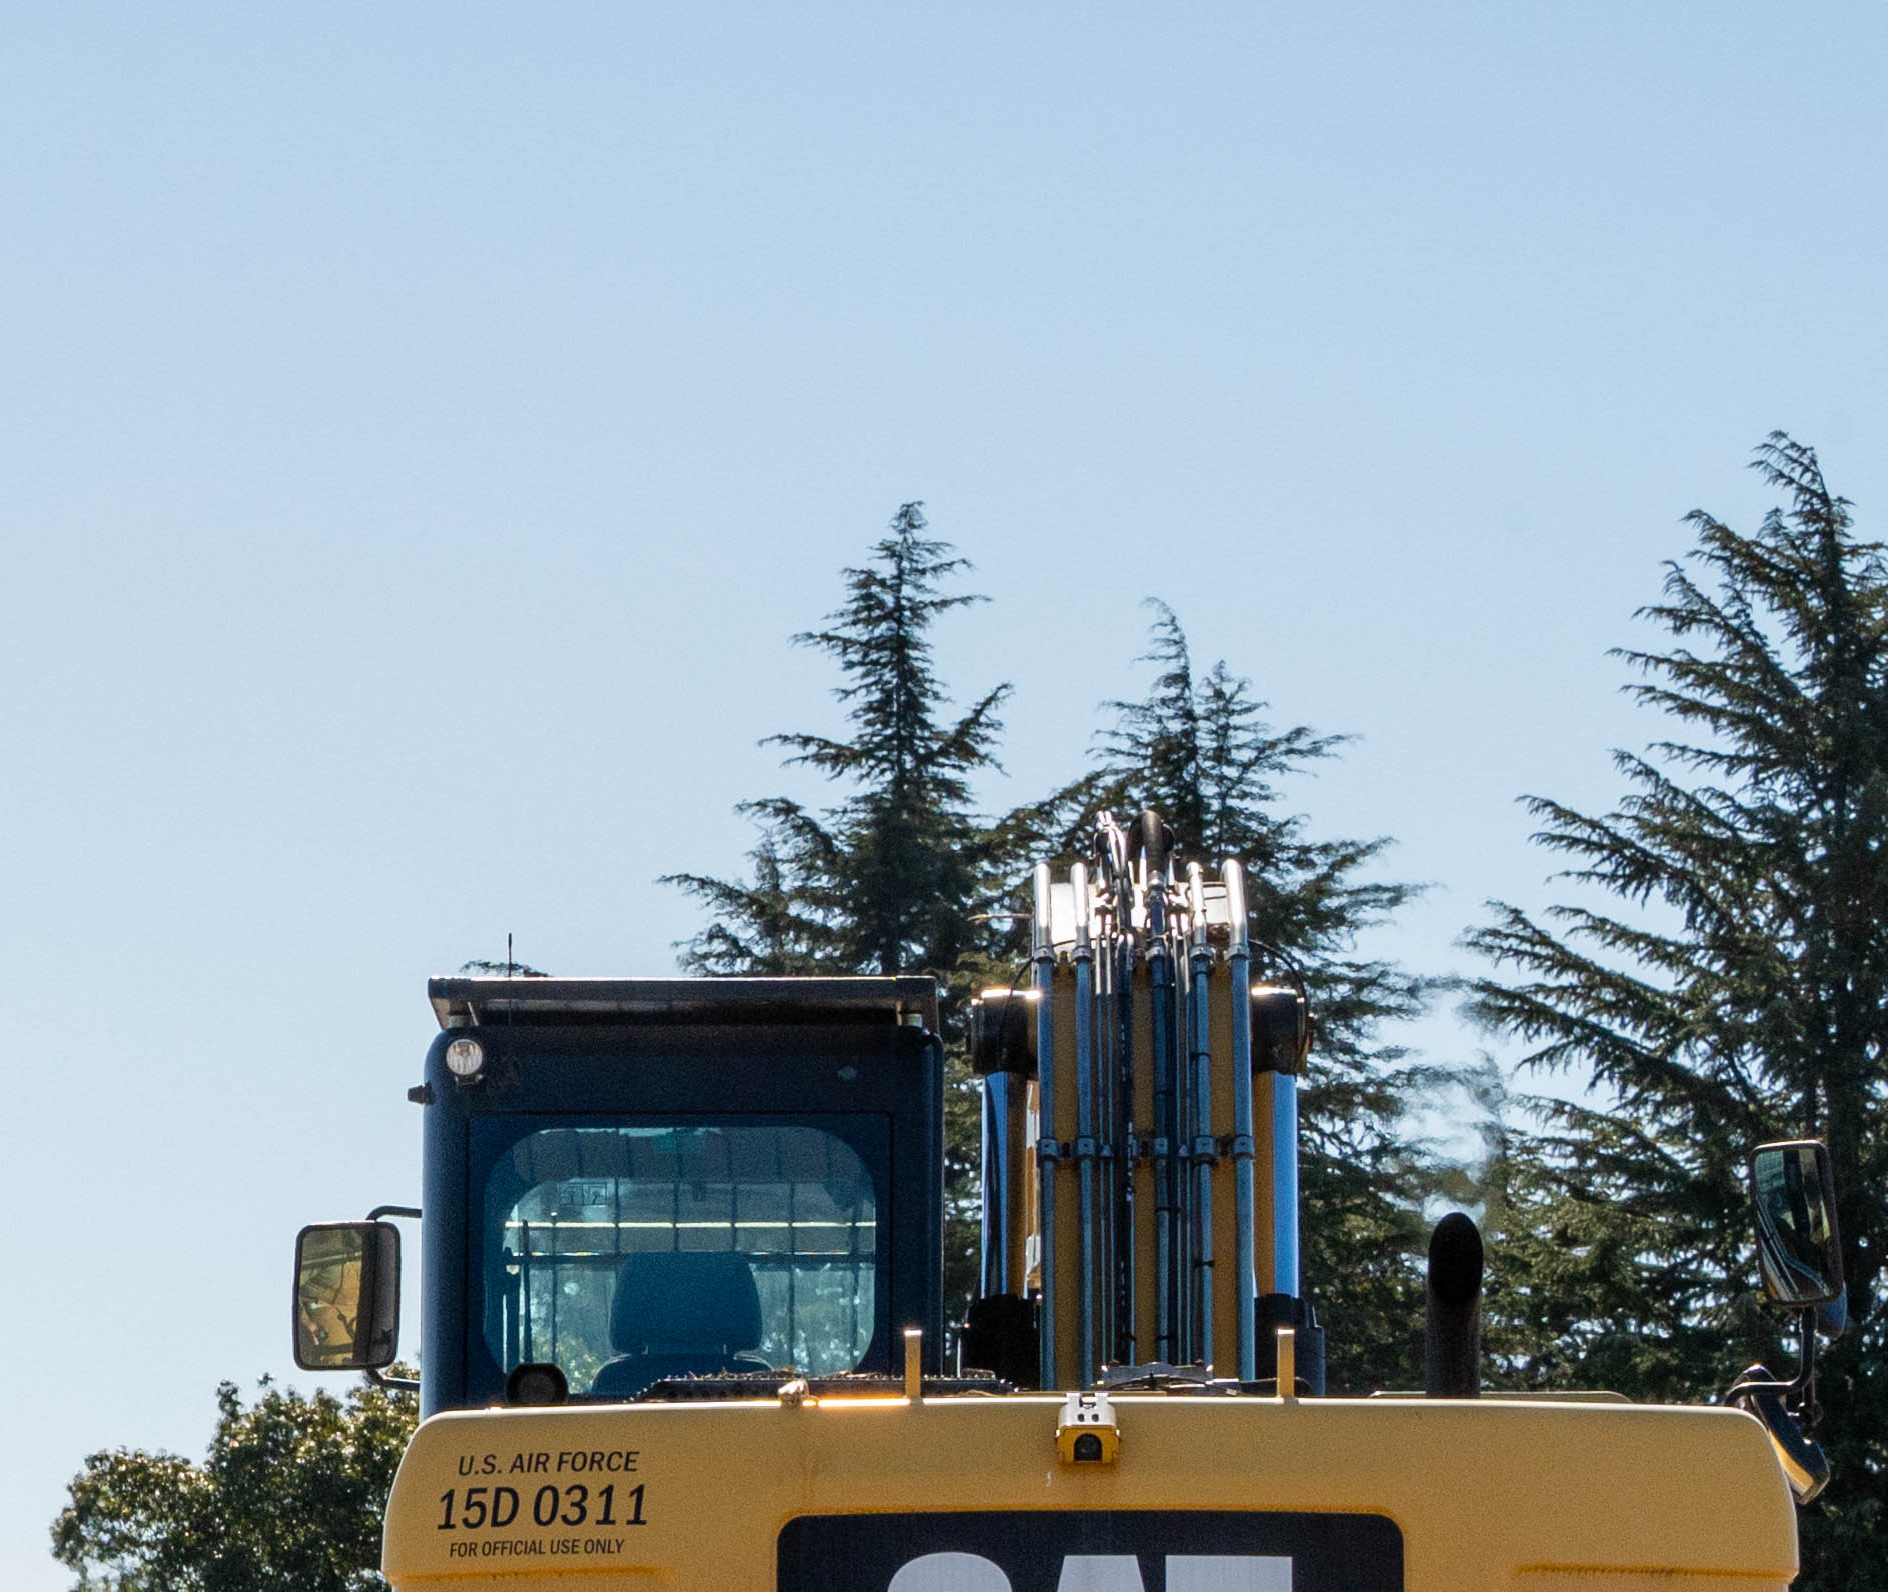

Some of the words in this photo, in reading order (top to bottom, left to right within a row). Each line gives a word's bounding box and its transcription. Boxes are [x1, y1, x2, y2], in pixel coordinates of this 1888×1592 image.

[458, 1454, 502, 1476] U.S.
[510, 1452, 550, 1474] AIR
[557, 1451, 640, 1472] FORCE
[437, 1486, 520, 1530] 15D
[533, 1484, 648, 1527] 0311
[450, 1542, 478, 1557] FOR
[481, 1540, 546, 1557] OFFICIAL
[550, 1539, 580, 1554] USE
[584, 1539, 625, 1554] ONLY
